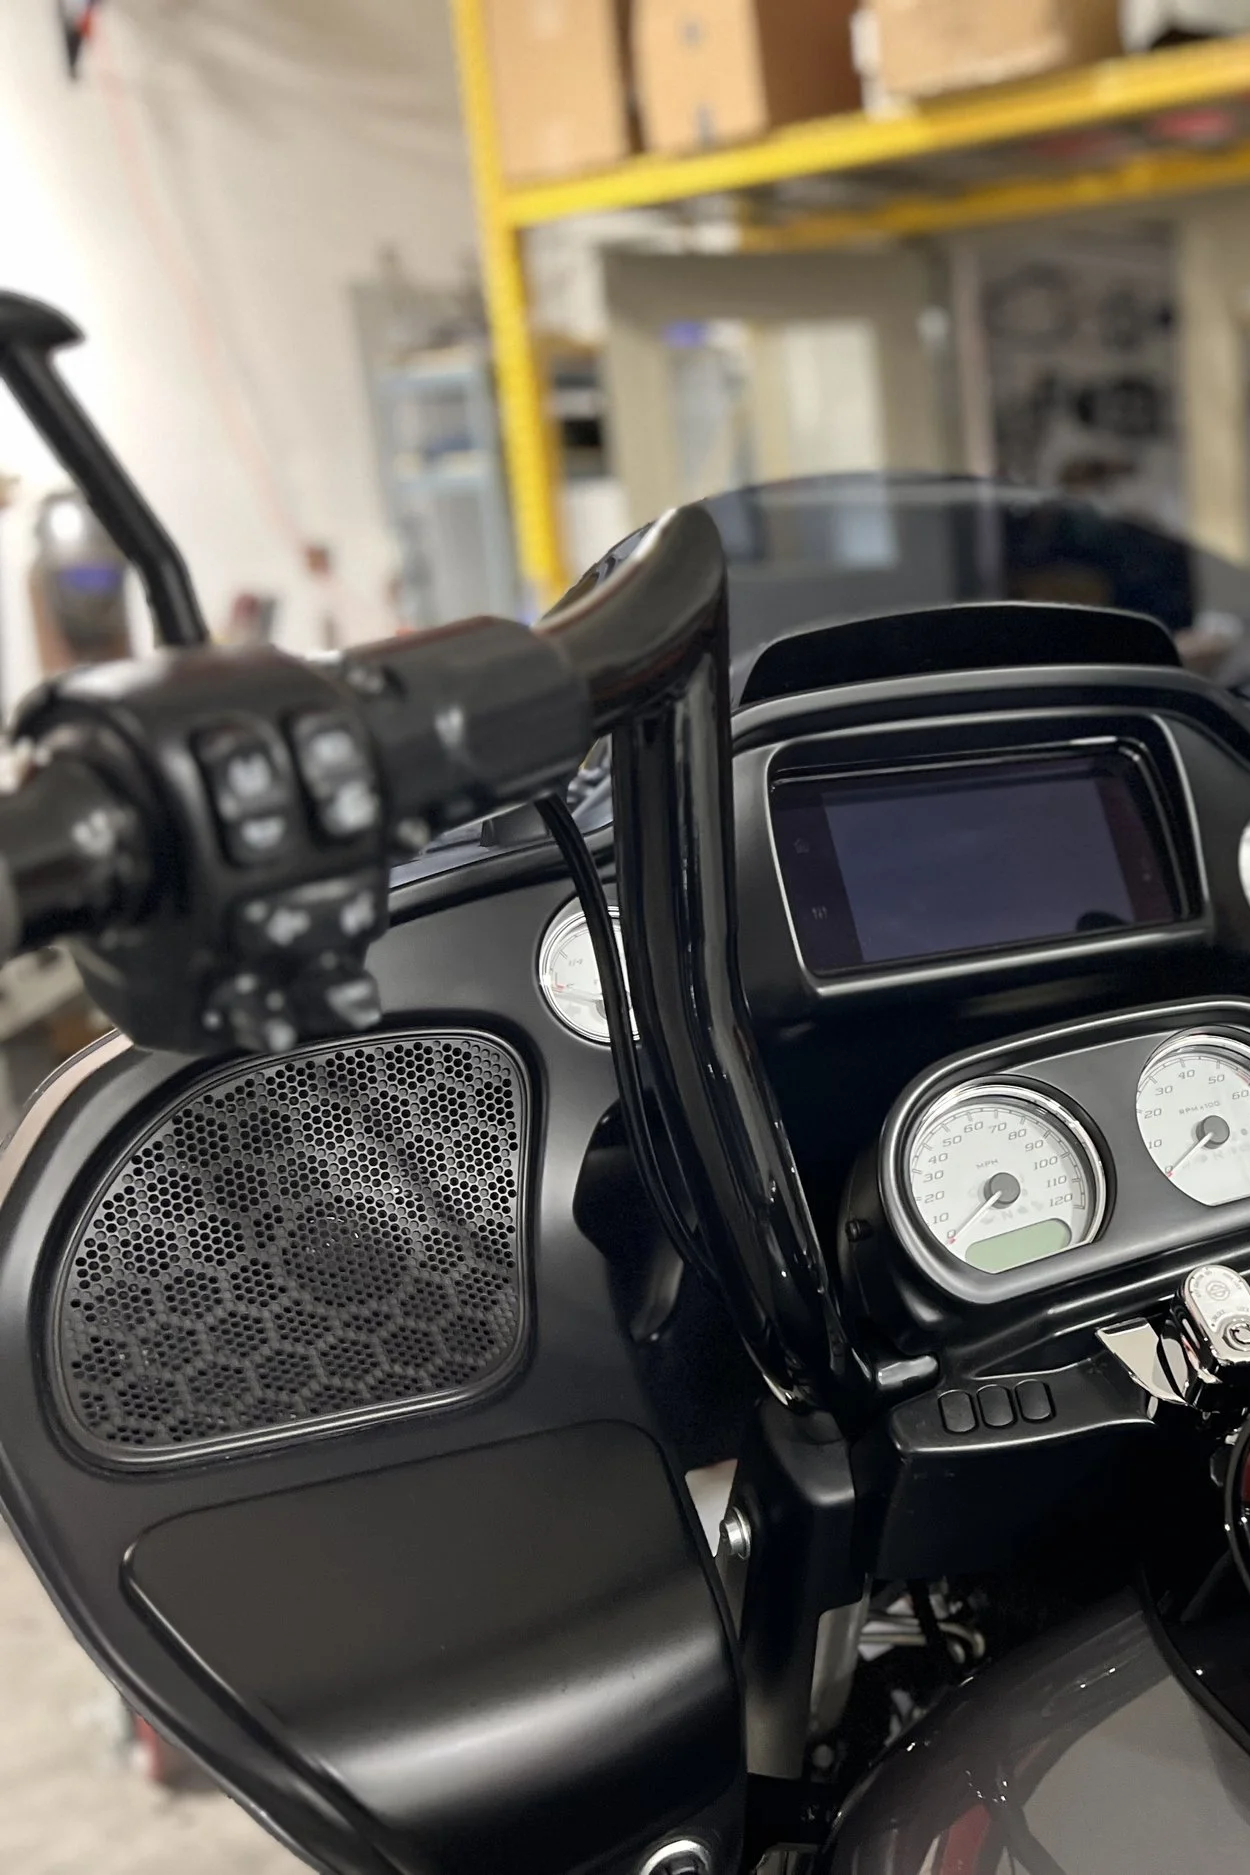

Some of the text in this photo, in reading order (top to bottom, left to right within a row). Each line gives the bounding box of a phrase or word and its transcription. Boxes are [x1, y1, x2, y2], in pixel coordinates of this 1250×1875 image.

[1178, 1069, 1196, 1080] 40
[1208, 1074, 1225, 1085] 50
[1155, 1085, 1173, 1096] 30
[1231, 1089, 1249, 1101] 60
[1144, 1108, 1162, 1119] 20
[963, 1121, 984, 1134] 60
[988, 1122, 1007, 1134] 70
[1008, 1128, 1027, 1141] 80
[942, 1135, 962, 1148] 50
[1024, 1139, 1044, 1152] 90
[1148, 1139, 1163, 1150] 10
[928, 1152, 948, 1164] 40
[976, 1159, 998, 1169] MPH
[1033, 1155, 1058, 1171] 100
[1164, 1165, 1174, 1175] 0
[923, 1170, 944, 1183] 30
[1047, 1175, 1067, 1188] 110
[924, 1191, 945, 1204] 20
[1050, 1193, 1073, 1207] 120
[933, 1212, 949, 1225] 10
[946, 1229, 957, 1239] 0
